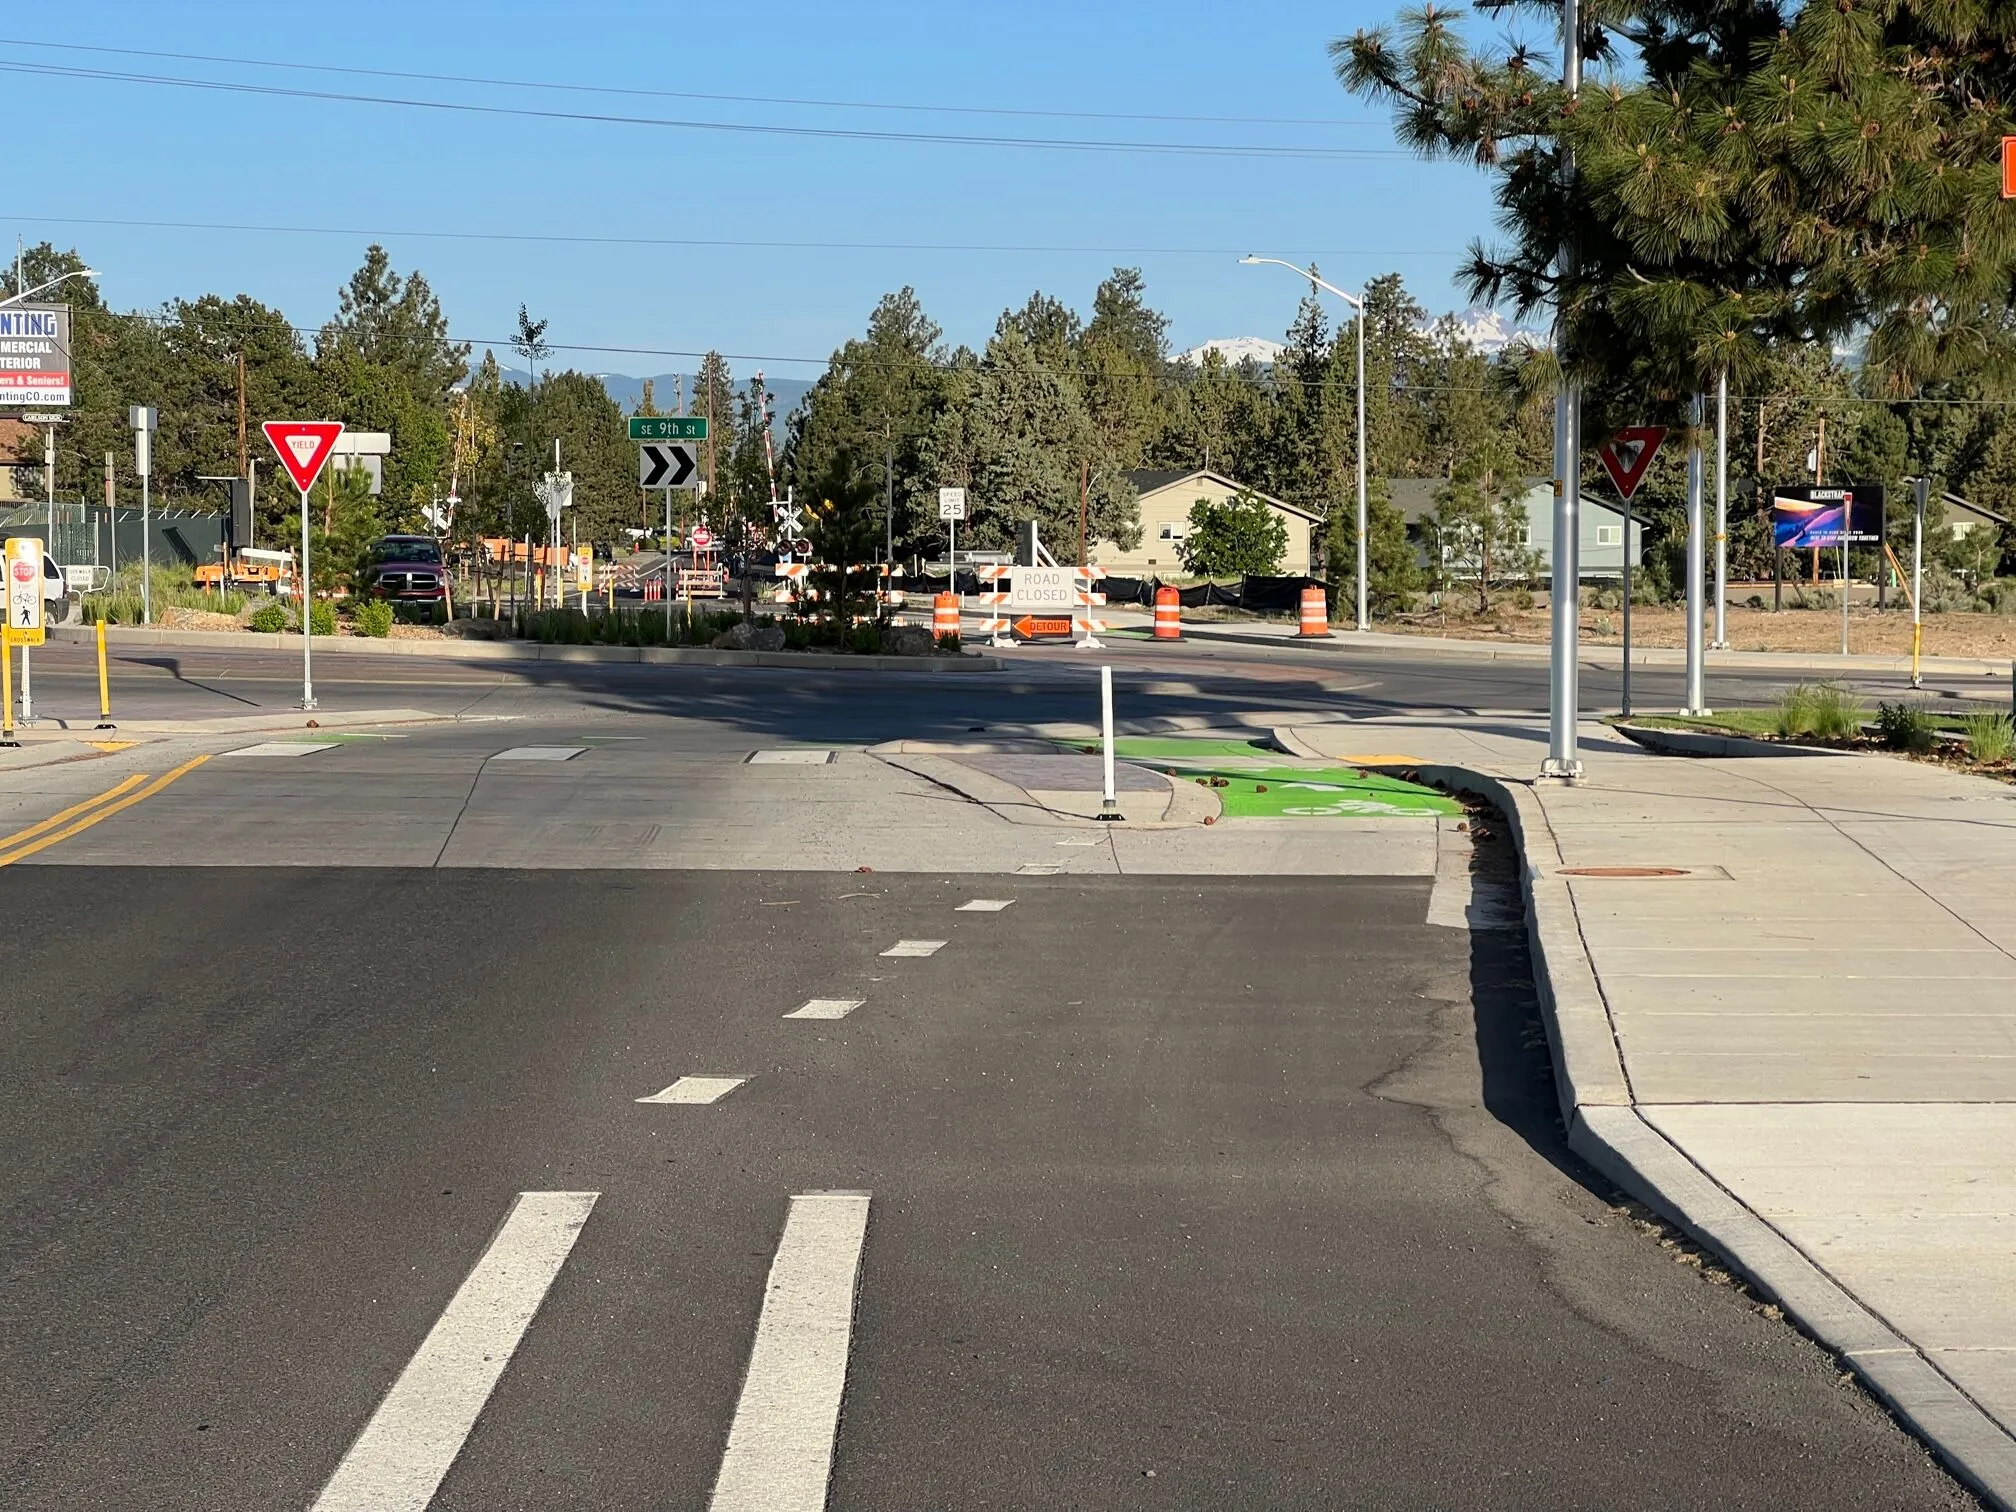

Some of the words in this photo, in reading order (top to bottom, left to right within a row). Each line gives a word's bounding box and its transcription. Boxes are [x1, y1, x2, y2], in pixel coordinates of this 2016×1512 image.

[17, 376, 24, 385] &
[27, 375, 65, 386] Seniors!
[641, 425, 653, 435] SE
[660, 422, 679, 435] 9th
[686, 425, 696, 435] St
[291, 440, 315, 449] YIELD
[943, 504, 961, 515] 25
[14, 567, 35, 577] STOP
[1024, 573, 1060, 585] ROAD
[1017, 589, 1067, 601] CLOSED
[1030, 622, 1067, 631] DETOUR
